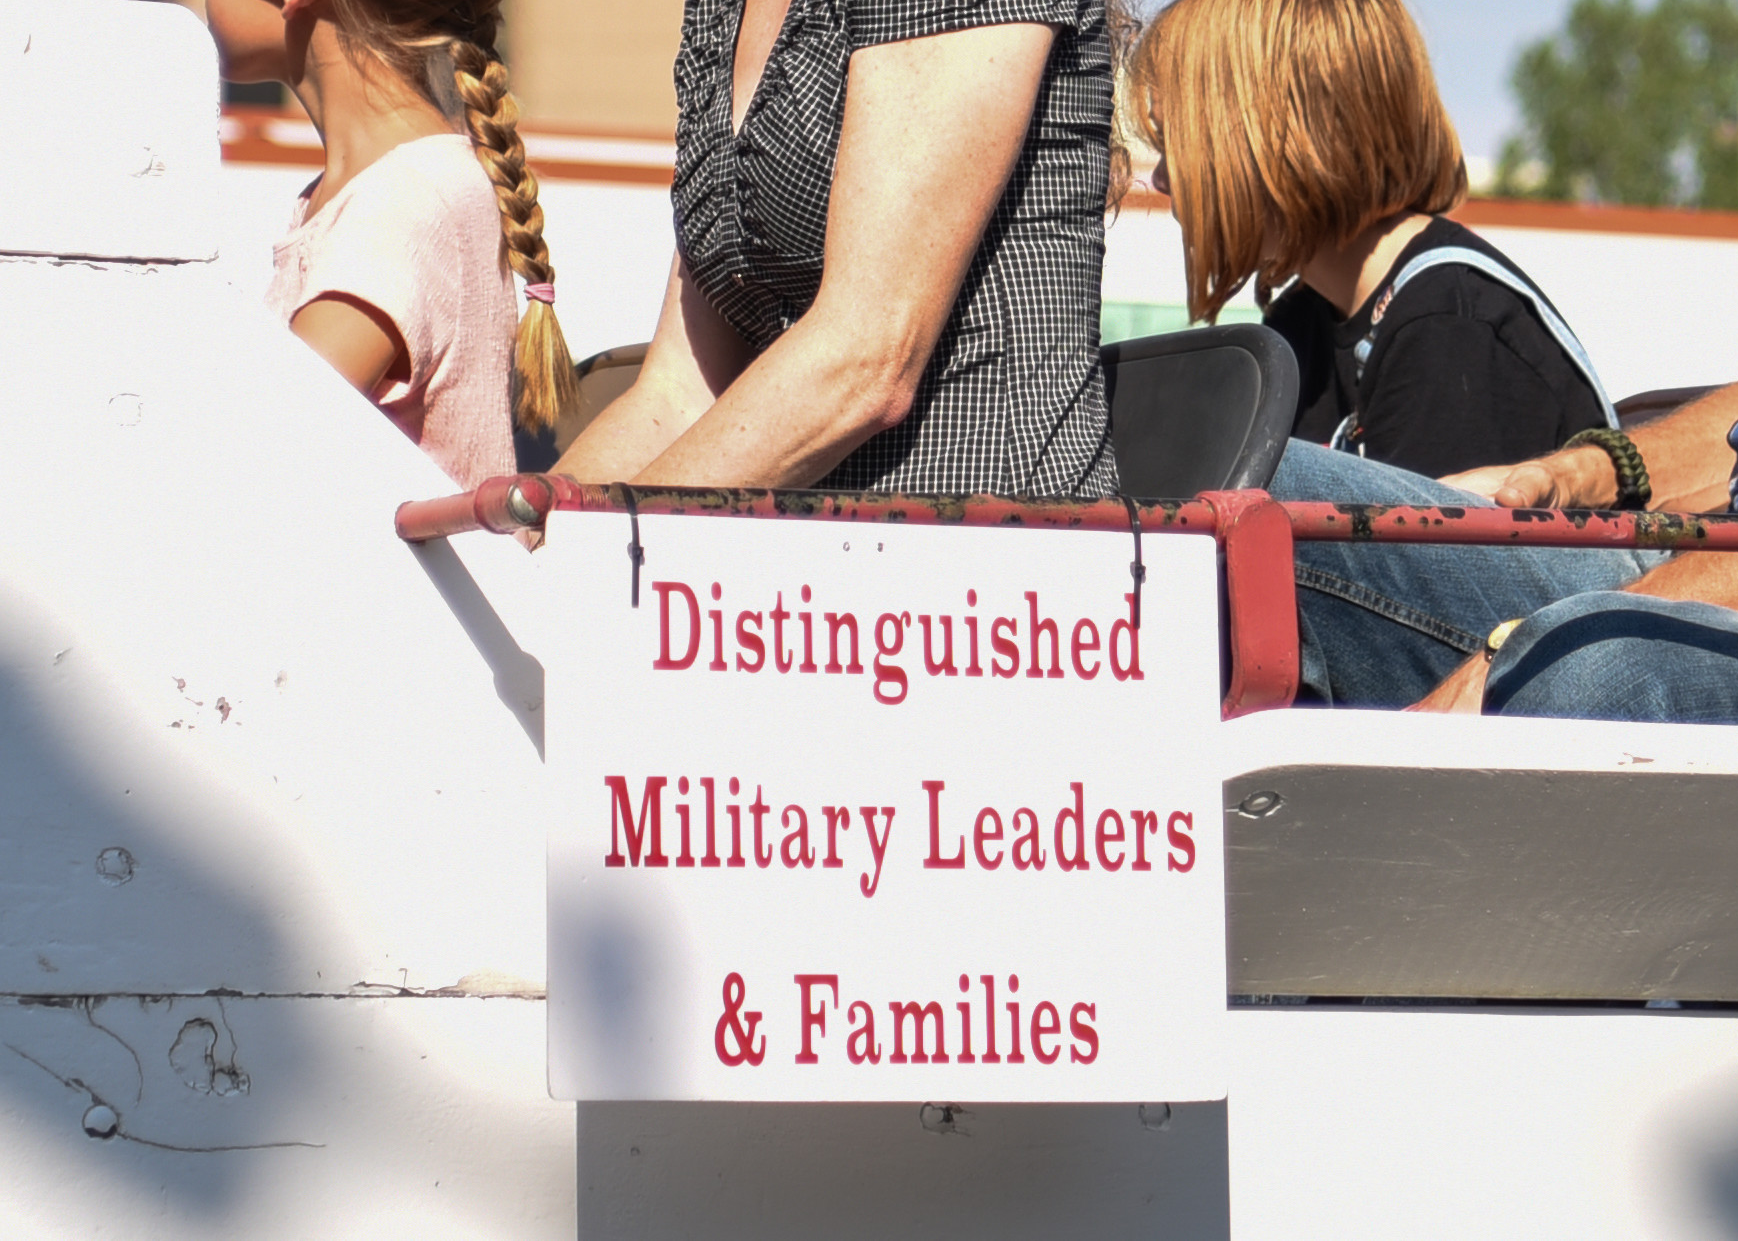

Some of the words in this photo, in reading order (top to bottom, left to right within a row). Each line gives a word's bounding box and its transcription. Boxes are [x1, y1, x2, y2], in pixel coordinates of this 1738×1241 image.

[651, 580, 1145, 706] Distinguished
[603, 775, 896, 899] Military
[921, 779, 1197, 874] Leaders
[713, 971, 767, 1068] &
[793, 973, 1101, 1066] Families
